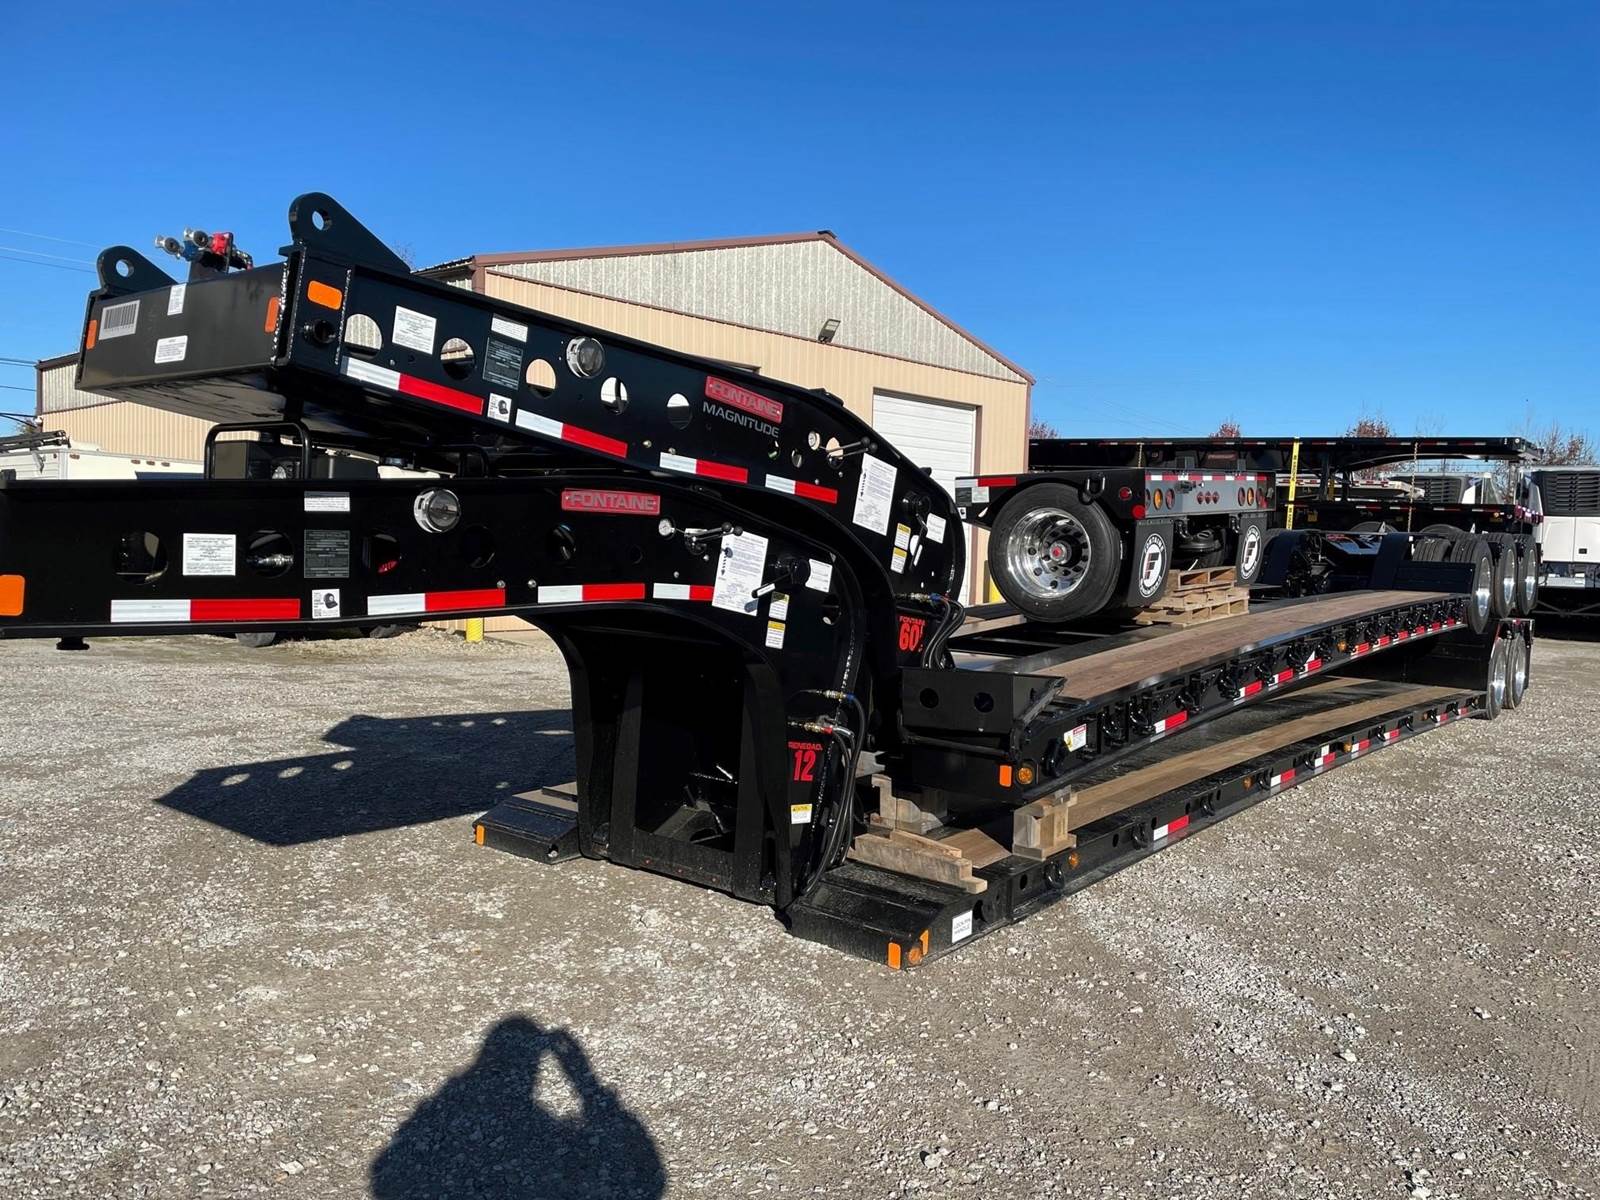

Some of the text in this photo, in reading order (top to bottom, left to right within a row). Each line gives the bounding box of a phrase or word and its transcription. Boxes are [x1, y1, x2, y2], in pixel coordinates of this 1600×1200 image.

[712, 381, 778, 416] FONTAINE
[703, 401, 780, 438] MAGNITUDE
[569, 491, 655, 510] FONTAINE
[794, 750, 816, 781] 12
